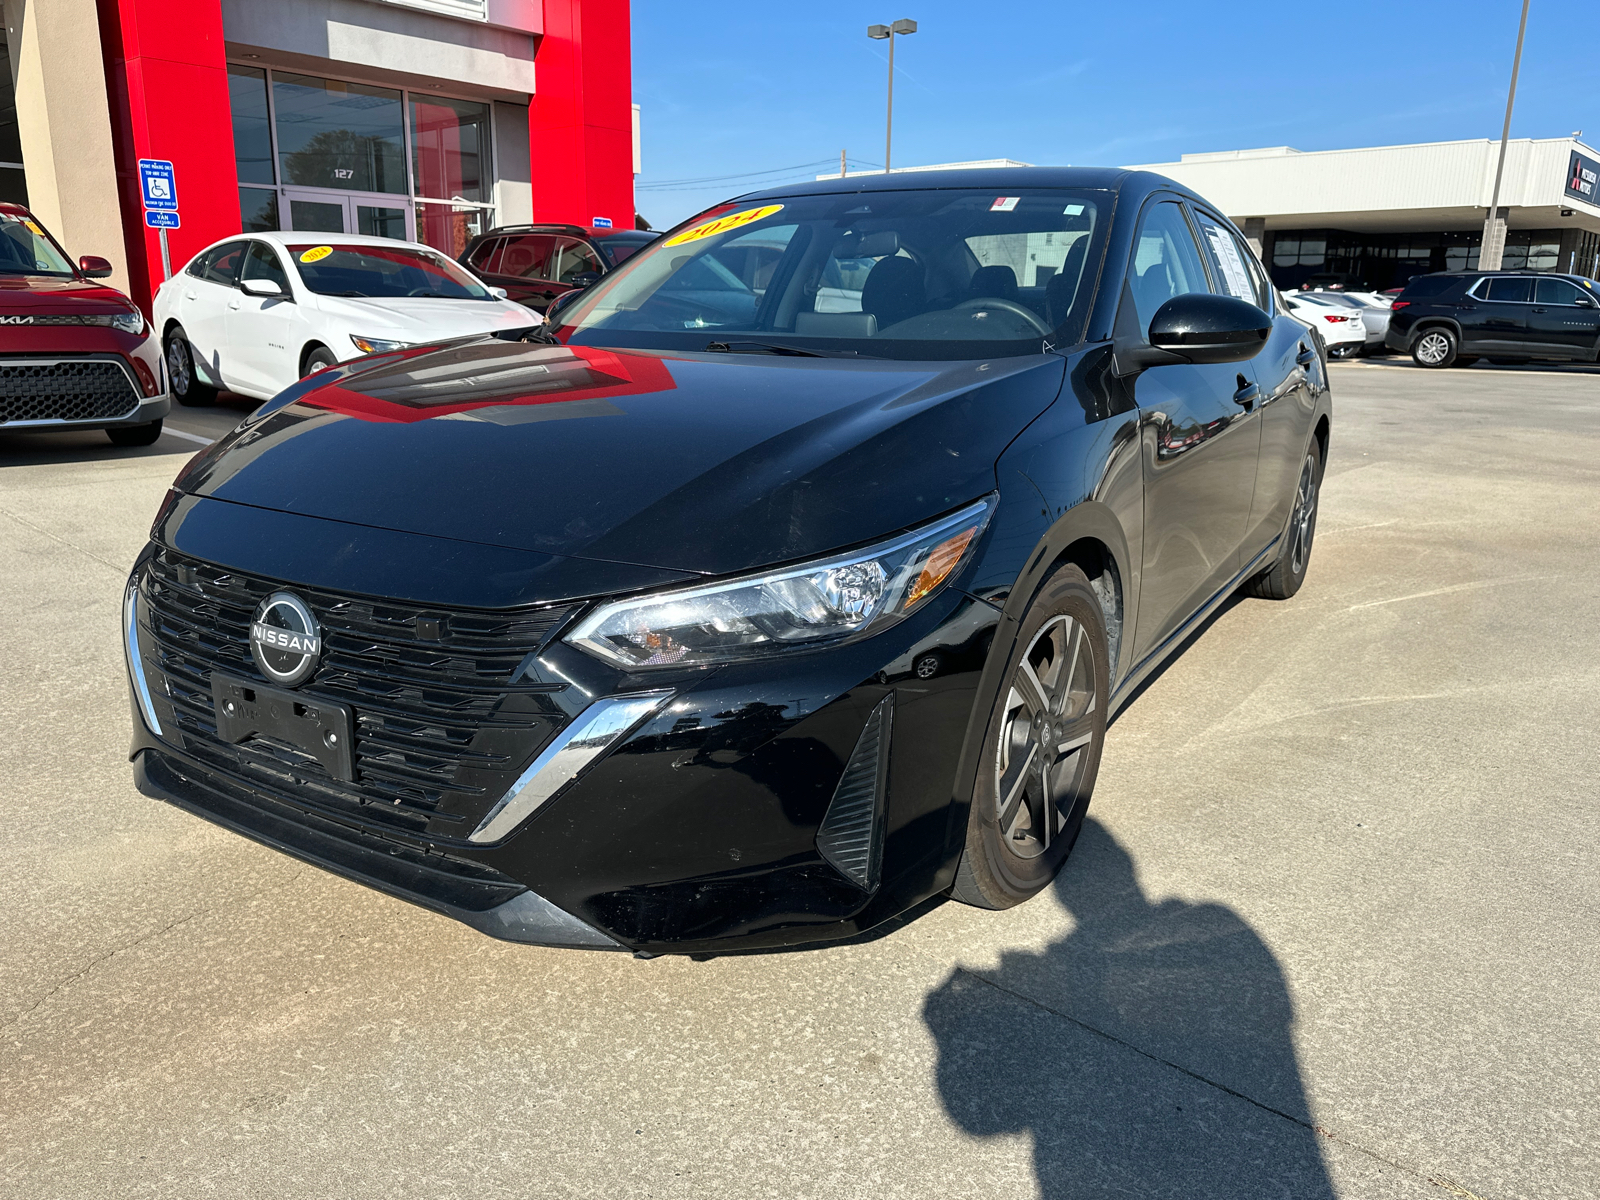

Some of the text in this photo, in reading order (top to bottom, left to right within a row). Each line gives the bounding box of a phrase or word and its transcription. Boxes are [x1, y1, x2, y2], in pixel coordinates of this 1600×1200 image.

[334, 169, 354, 179] 127
[680, 208, 765, 243] 2024
[305, 247, 328, 261] 2024
[253, 624, 317, 652] NISSAN
